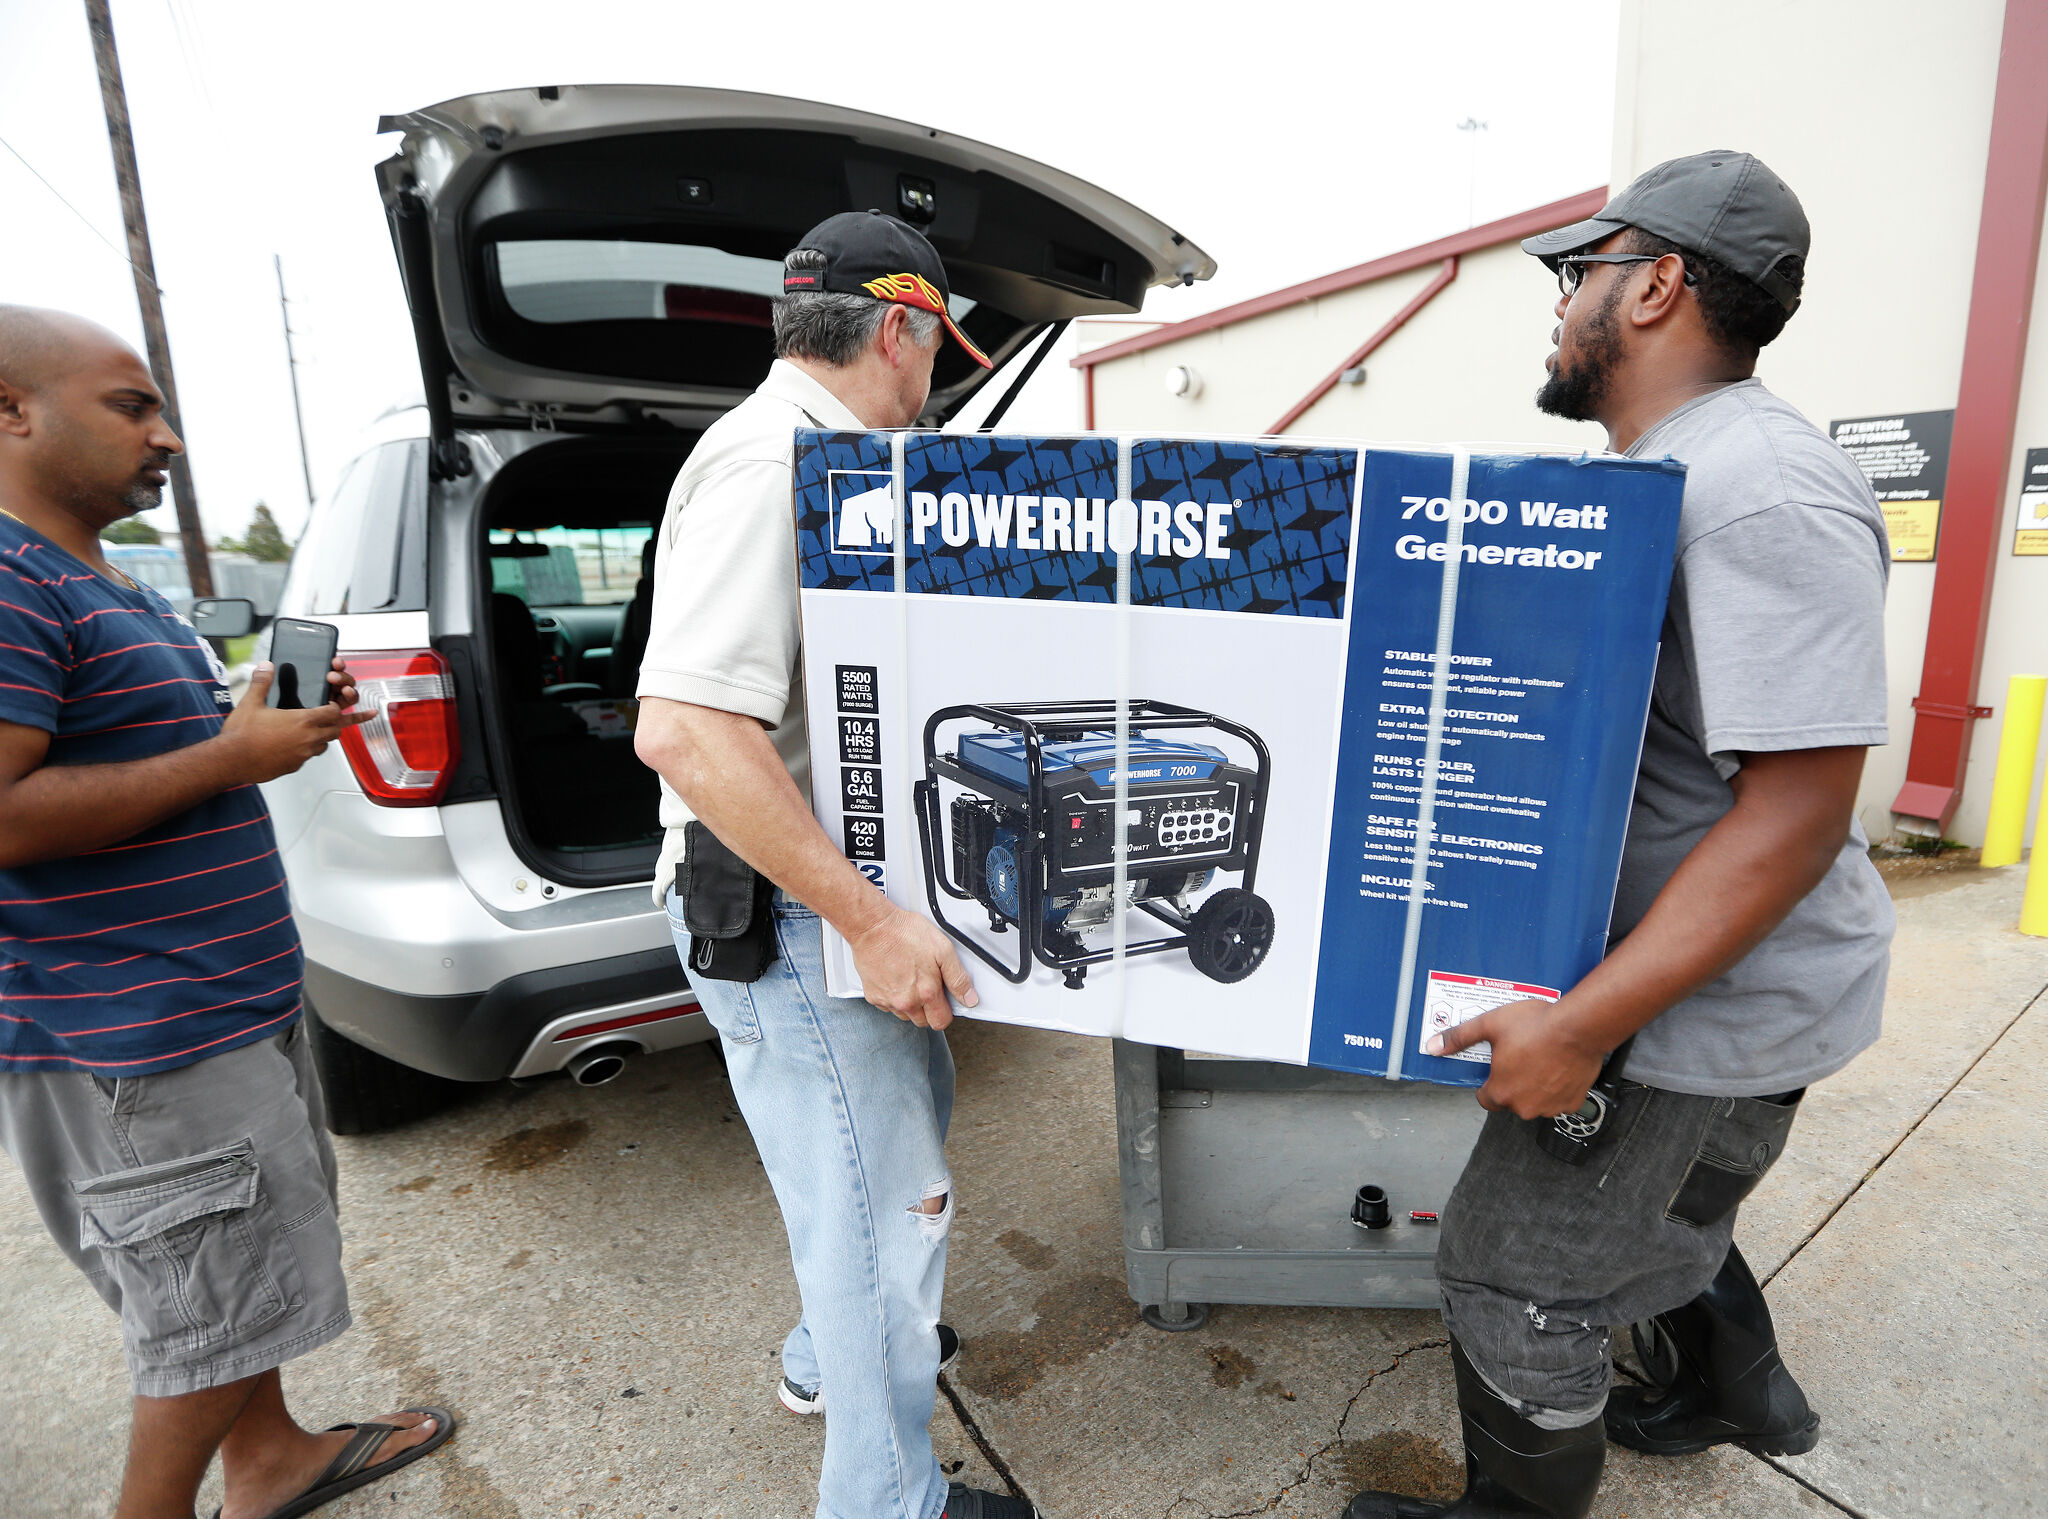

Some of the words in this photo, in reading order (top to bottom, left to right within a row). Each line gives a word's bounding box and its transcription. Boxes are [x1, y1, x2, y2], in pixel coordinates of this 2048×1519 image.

[1835, 418, 1904, 435] ATTENTION
[1401, 496, 1508, 525] 7000
[1519, 500, 1609, 530] Watt
[1395, 534, 1603, 570] Generator
[1384, 650, 1437, 663] STABLE
[1449, 655, 1493, 667] OWER
[842, 671, 872, 684] 5500
[1382, 666, 1427, 678] Automatic
[1461, 673, 1501, 683] regulator
[1502, 676, 1521, 685] with
[1522, 678, 1565, 688] voltmeter
[842, 691, 873, 701] WATTS
[843, 683, 871, 692] RATED
[1382, 680, 1416, 689] ensures
[1464, 686, 1497, 695] reliable
[1498, 689, 1526, 698] power
[1379, 703, 1426, 716] EXTRA
[1429, 707, 1520, 724] OTECTION
[844, 720, 875, 736] 10.4
[1376, 731, 1405, 741] engine
[1406, 733, 1427, 742] from
[1377, 718, 1396, 727] Low
[1396, 721, 1408, 729] oil
[1451, 726, 1509, 739] automatically
[1509, 732, 1546, 741] protects
[845, 734, 875, 748] HRS
[1170, 765, 1197, 777] 7000
[1374, 754, 1413, 766] RUNS
[1415, 758, 1476, 774] COLER,
[850, 769, 873, 784] 6.6
[1372, 765, 1415, 778] LASTS
[1416, 770, 1475, 784] LNGER
[846, 783, 878, 798] GAL
[1372, 781, 1394, 790] 100%
[1453, 789, 1495, 801] generator
[1495, 793, 1518, 803] head
[1518, 797, 1547, 807] allows
[850, 803, 877, 811] CAPACITY
[1369, 793, 1416, 804] continuous
[1416, 798, 1456, 808] oation
[1456, 802, 1490, 812] without
[1489, 805, 1541, 819] overheating
[850, 821, 877, 836] 420
[1367, 814, 1405, 827] SAFE
[1406, 818, 1437, 830] FR
[855, 835, 874, 848] CC
[1366, 825, 1440, 842] SENSITE
[1440, 833, 1544, 855] ELECTRONICS
[1363, 853, 1399, 863] sensitive
[1364, 841, 1384, 850] Less
[1384, 843, 1403, 852] than
[1437, 849, 1464, 860] allows
[1464, 852, 1479, 861] for
[1478, 854, 1504, 865] safely
[1504, 858, 1538, 870] running
[1361, 873, 1436, 891] INCLUDS:
[1359, 888, 1385, 899] Wheel
[1385, 891, 1397, 900] kit
[1397, 894, 1412, 902] wit
[1449, 899, 1469, 909] tires
[1483, 979, 1515, 991] DANGER
[1343, 1033, 1383, 1050] 750140
